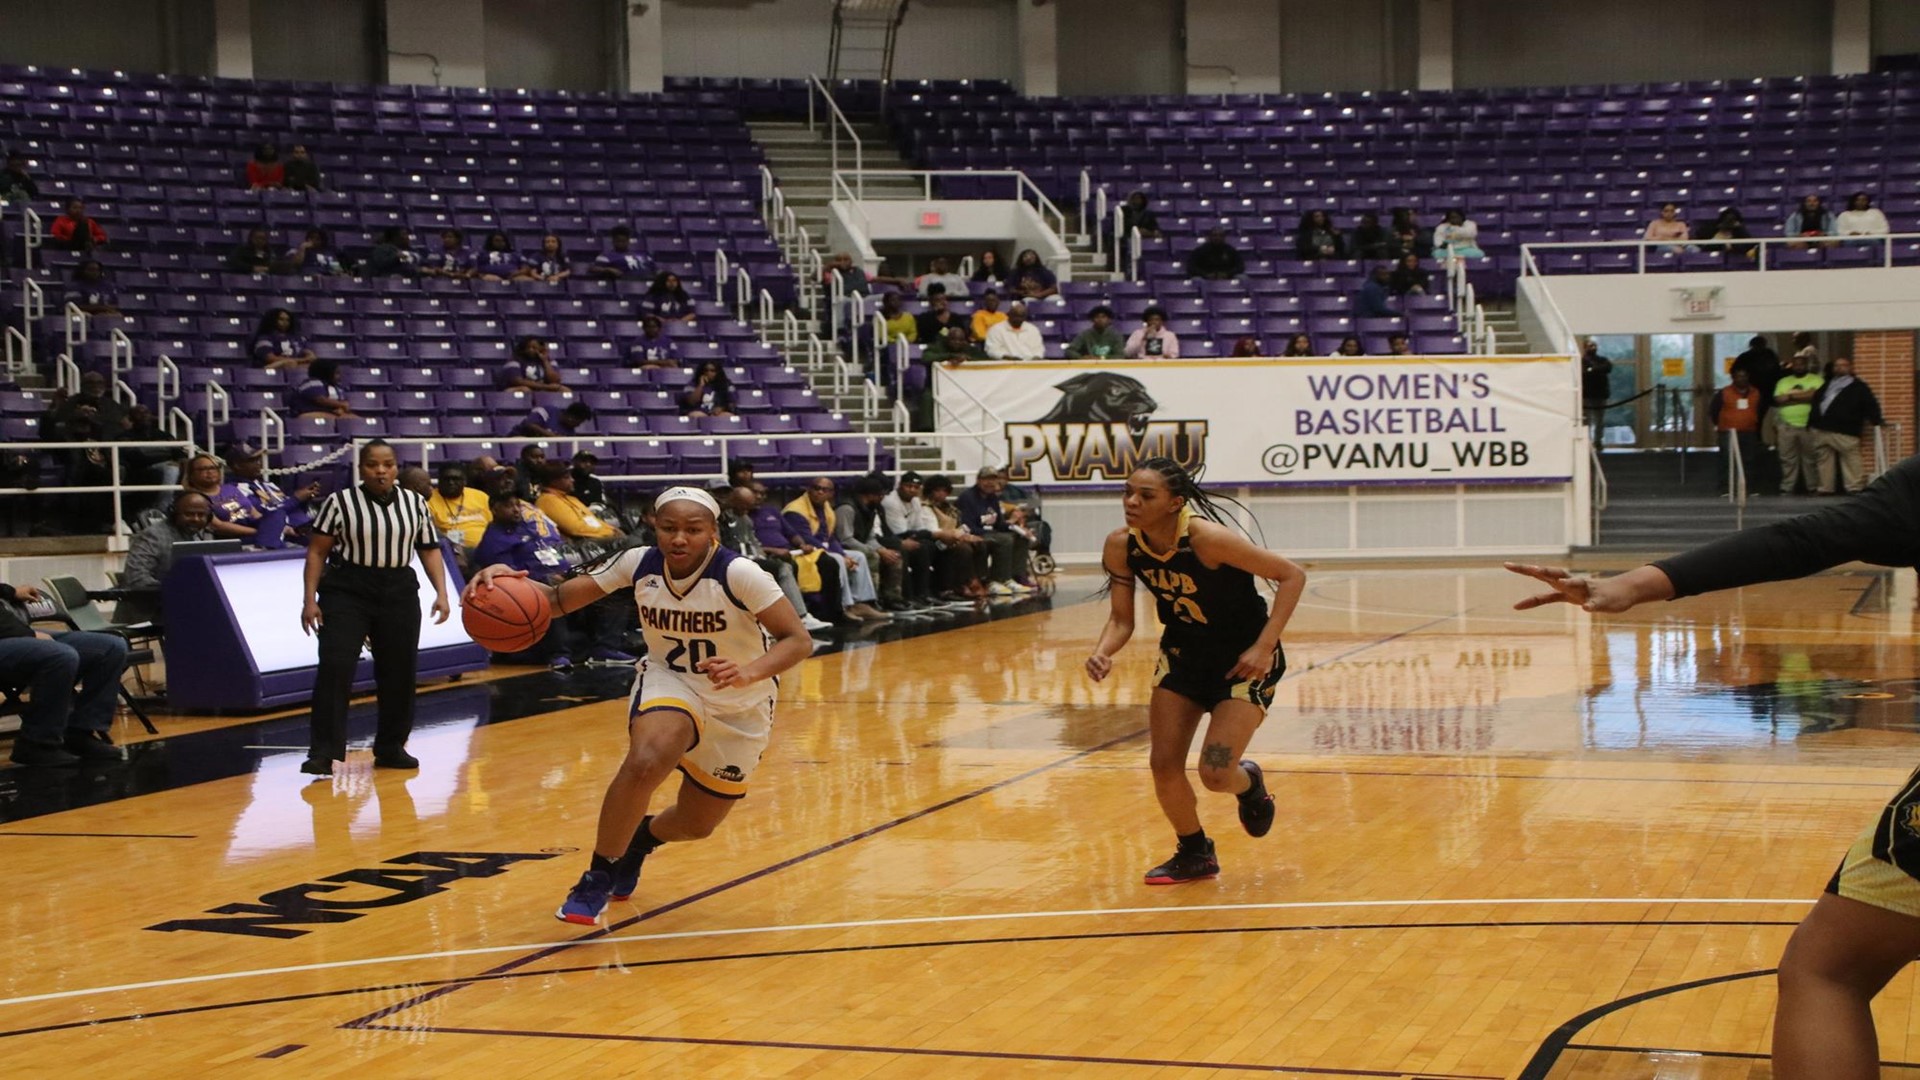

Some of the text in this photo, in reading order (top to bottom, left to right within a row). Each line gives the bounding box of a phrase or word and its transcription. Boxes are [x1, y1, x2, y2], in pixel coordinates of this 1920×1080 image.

[1307, 373, 1490, 401] WOMEN'S
[1295, 407, 1506, 435] BASKETBALL
[1005, 420, 1208, 481] PVAMU
[1261, 441, 1529, 475] @PVAMU_WBB
[640, 604, 727, 633] PANTHERS
[662, 635, 717, 675] 20
[142, 851, 563, 939] NCAA
